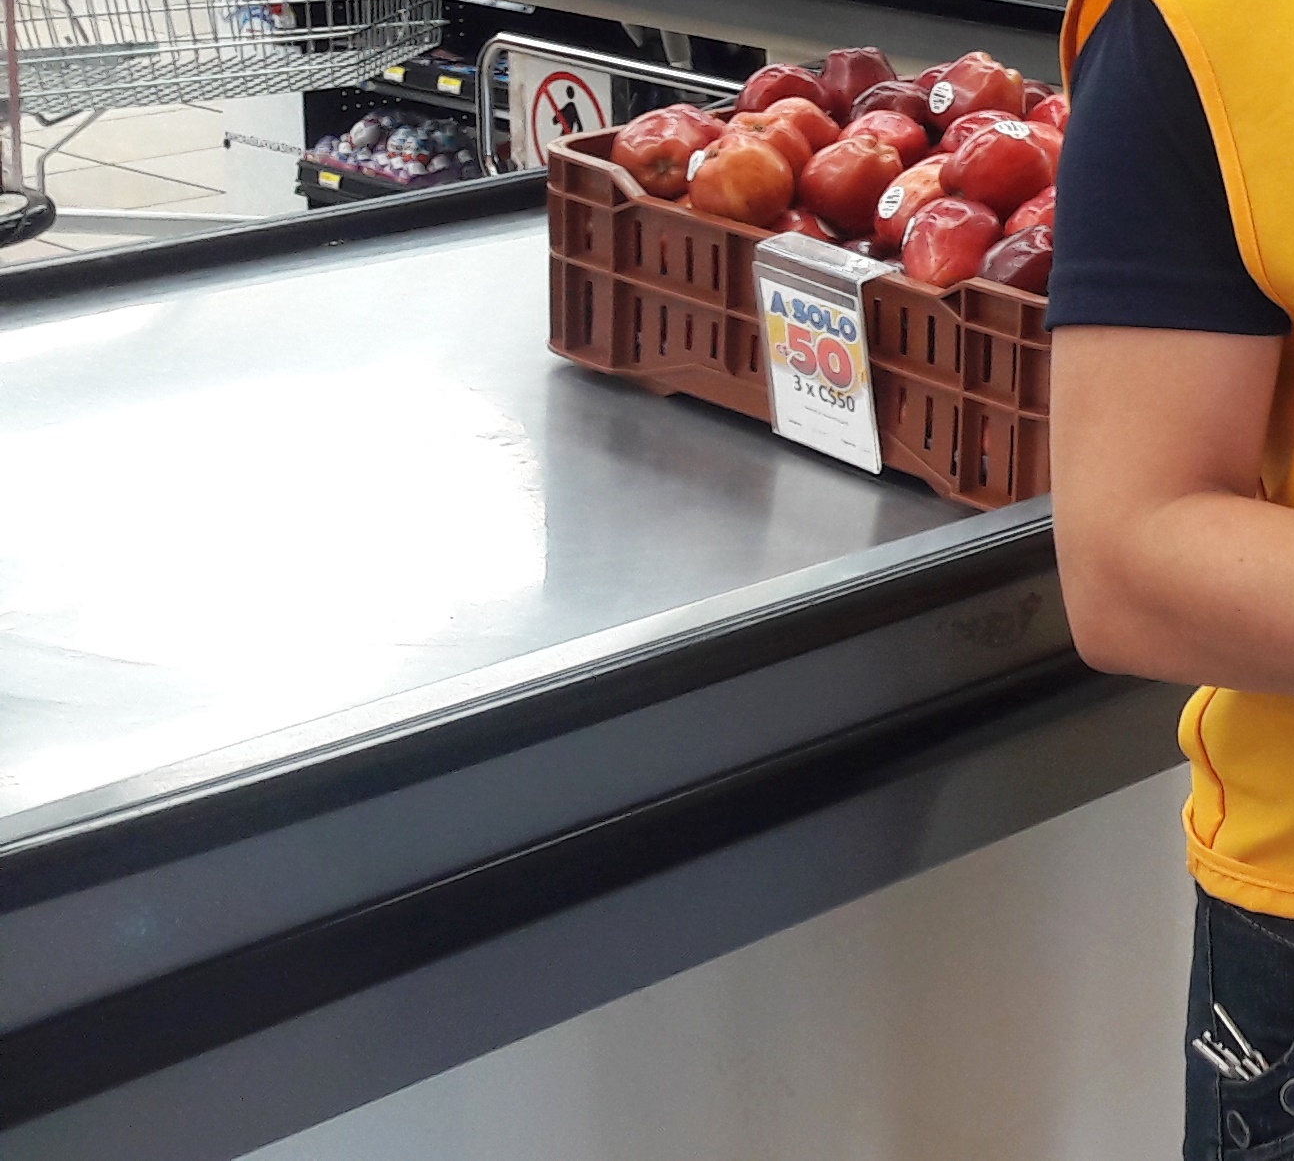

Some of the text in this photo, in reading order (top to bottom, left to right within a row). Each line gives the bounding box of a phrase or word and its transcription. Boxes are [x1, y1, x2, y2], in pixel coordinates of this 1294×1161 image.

[770, 290, 858, 343] A SOLO
[787, 322, 854, 389] 50
[793, 374, 856, 413] 3 x C$50
